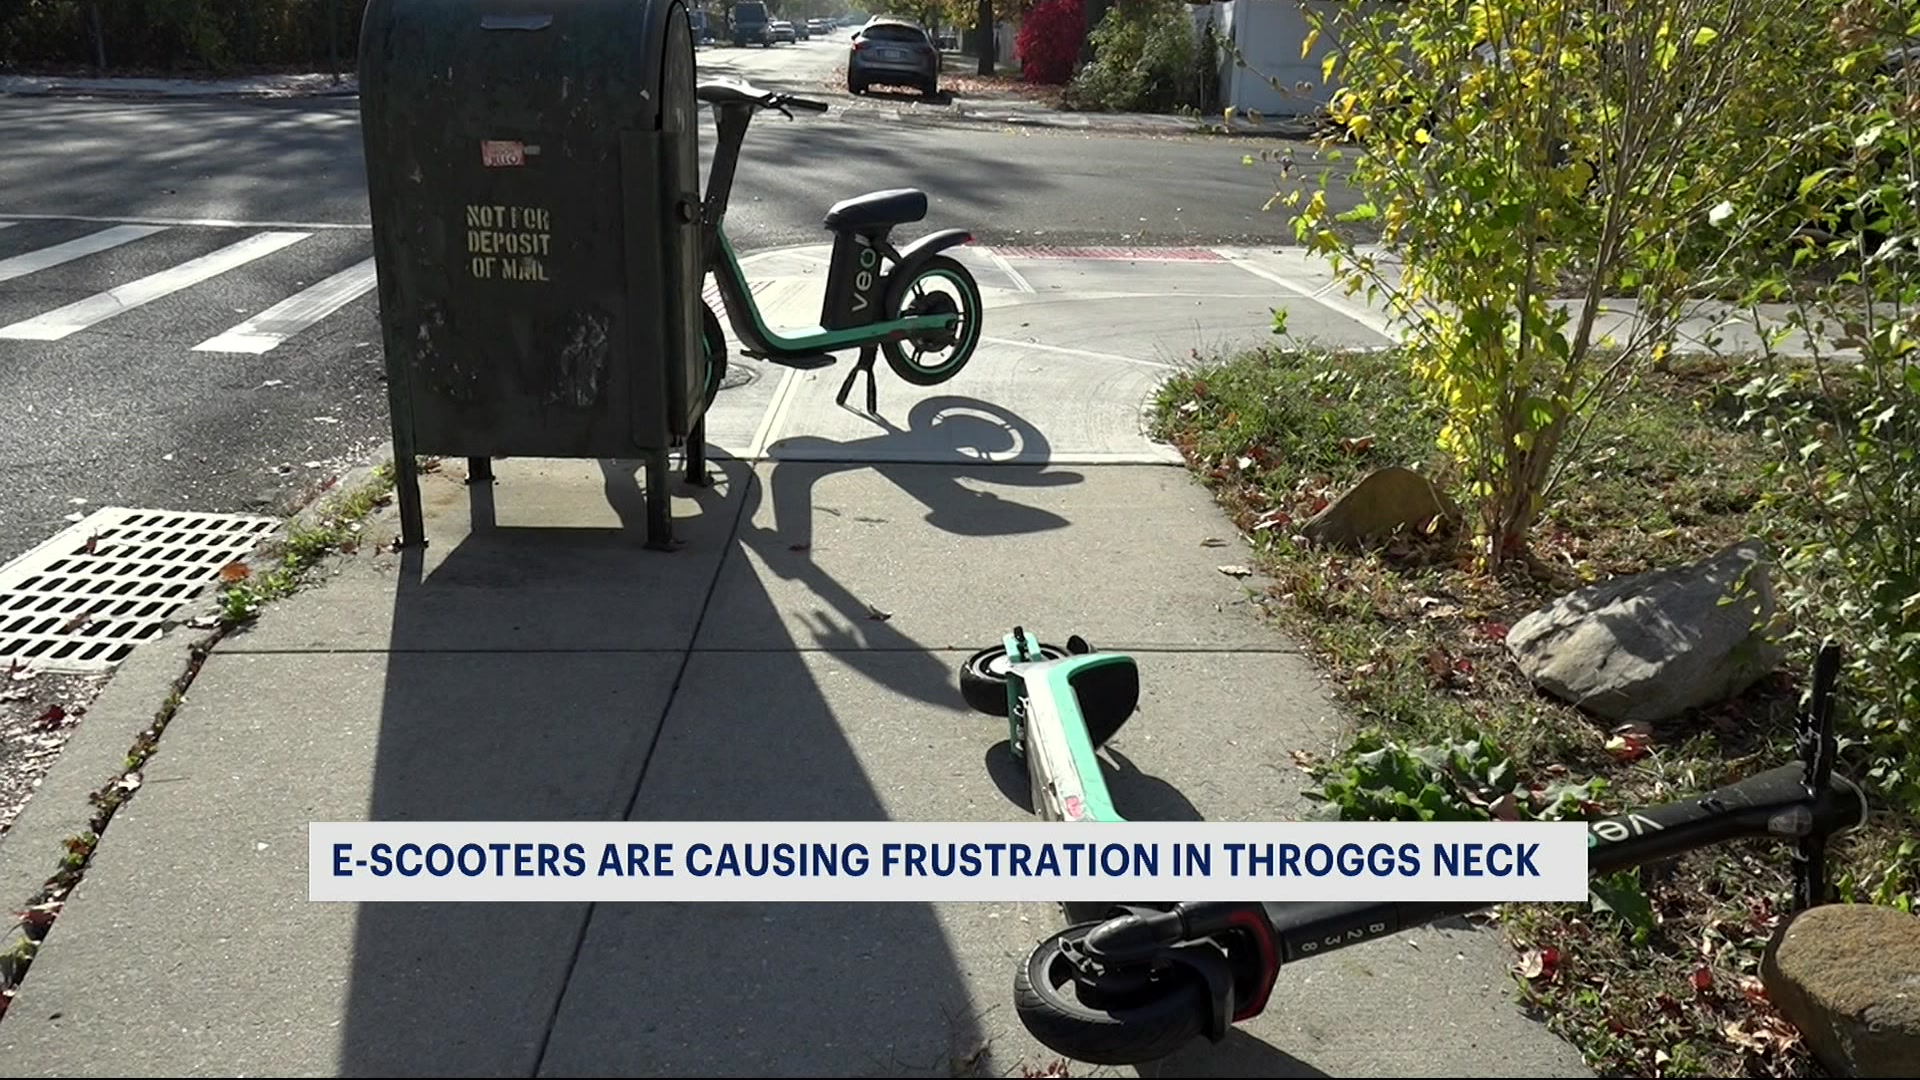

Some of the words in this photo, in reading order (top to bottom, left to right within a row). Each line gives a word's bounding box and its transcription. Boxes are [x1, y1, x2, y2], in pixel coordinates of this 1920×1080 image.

[466, 205, 506, 228] NOT
[510, 206, 550, 231] FOR
[467, 230, 551, 256] DEPOSIT
[472, 257, 497, 278] OF
[502, 257, 551, 281] MAIL
[852, 248, 877, 312] veo
